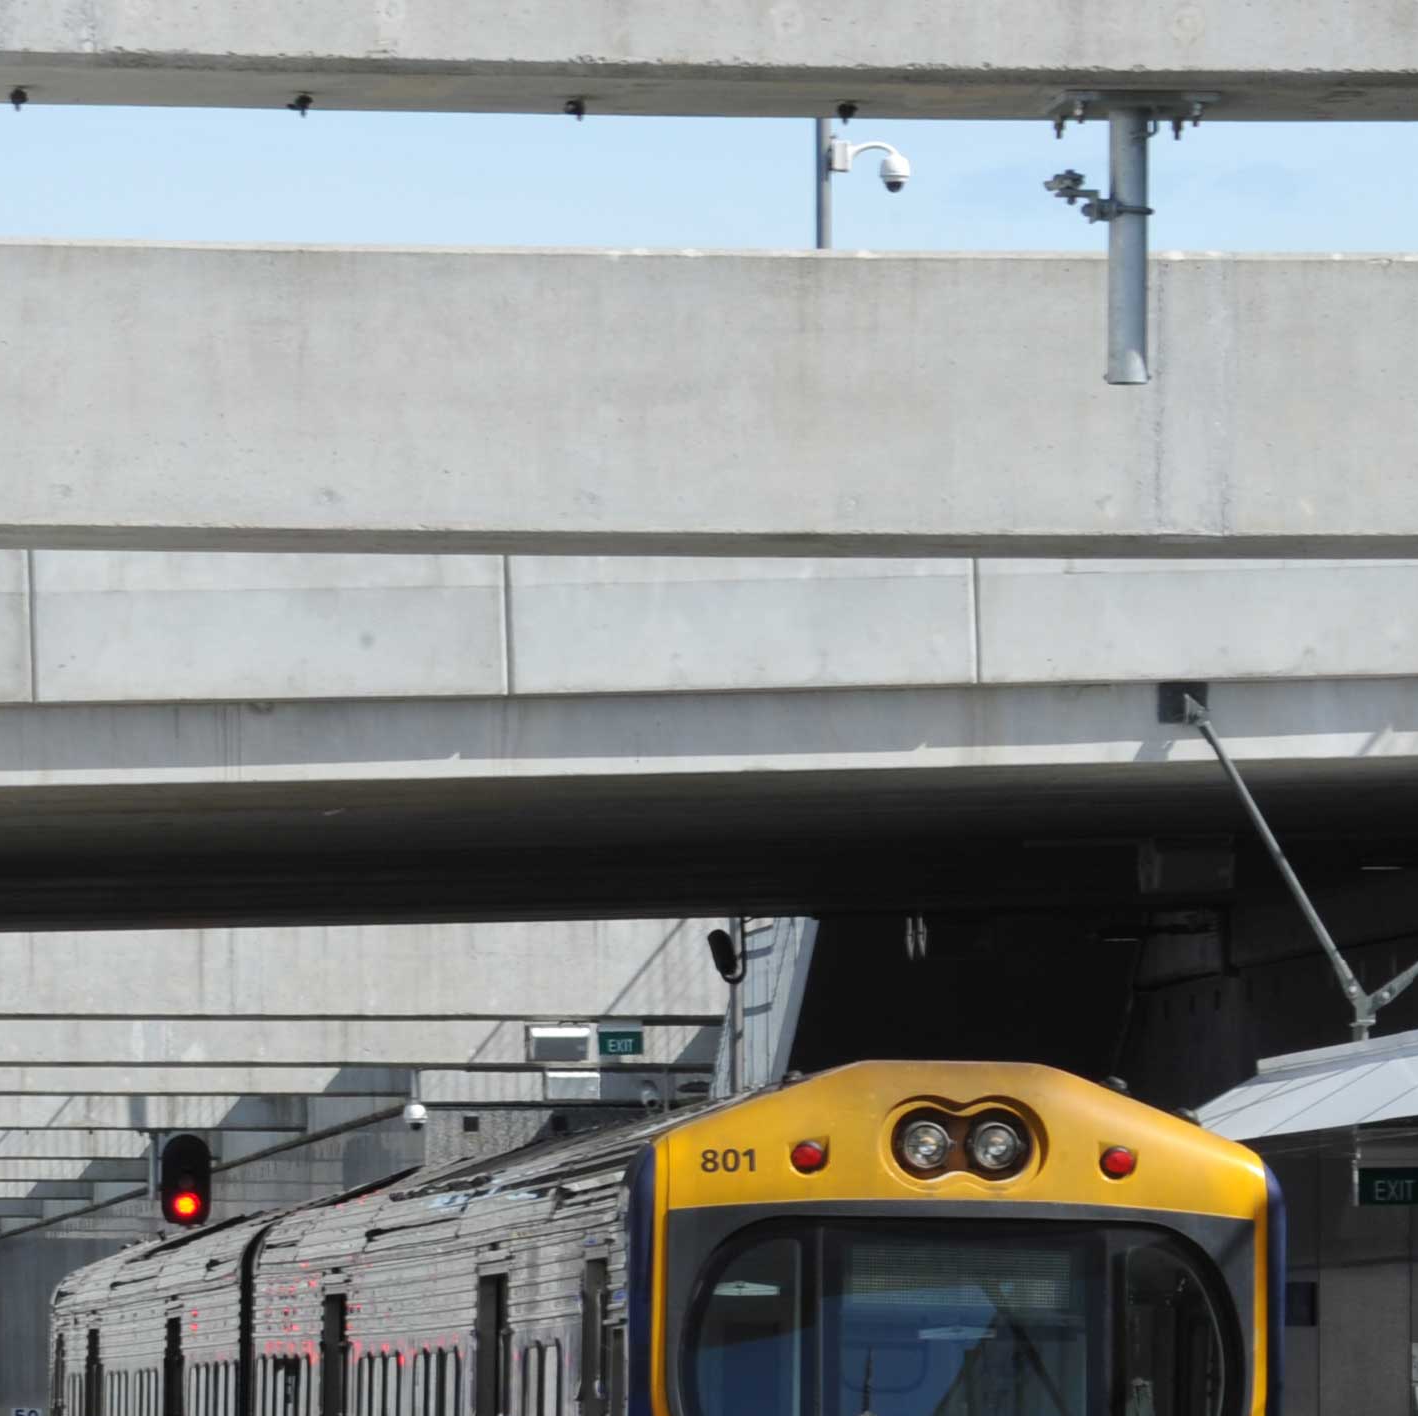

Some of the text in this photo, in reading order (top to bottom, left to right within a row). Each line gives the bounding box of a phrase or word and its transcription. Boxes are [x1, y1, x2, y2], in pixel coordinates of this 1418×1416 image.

[608, 1038, 634, 1052] EXIT
[701, 1148, 756, 1173] 801
[1374, 1179, 1416, 1201] EXIT
